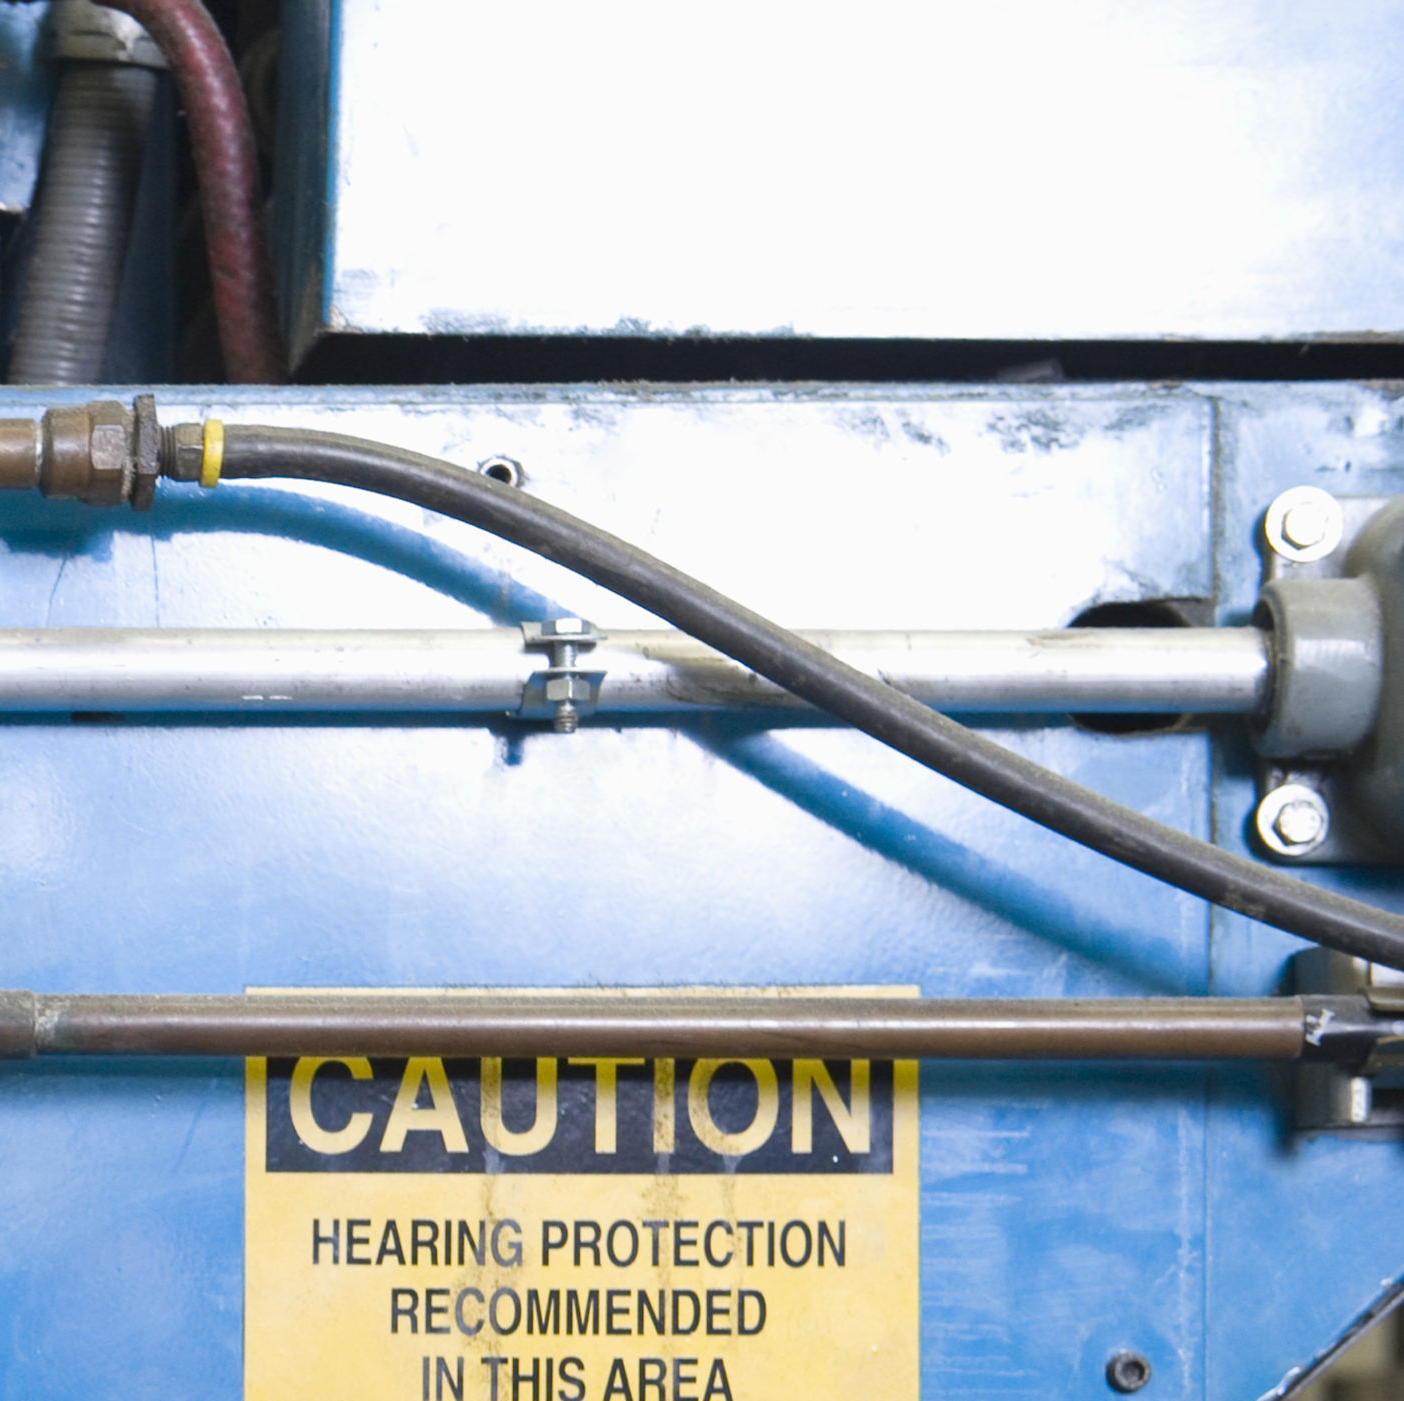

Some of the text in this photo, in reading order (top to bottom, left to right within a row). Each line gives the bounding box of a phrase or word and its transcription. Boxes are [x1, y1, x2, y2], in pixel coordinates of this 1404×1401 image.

[289, 1057, 871, 1156] CAUTION
[312, 1218, 846, 1268] HEARING PROTECTION
[391, 1288, 767, 1336] RECOMMENDED
